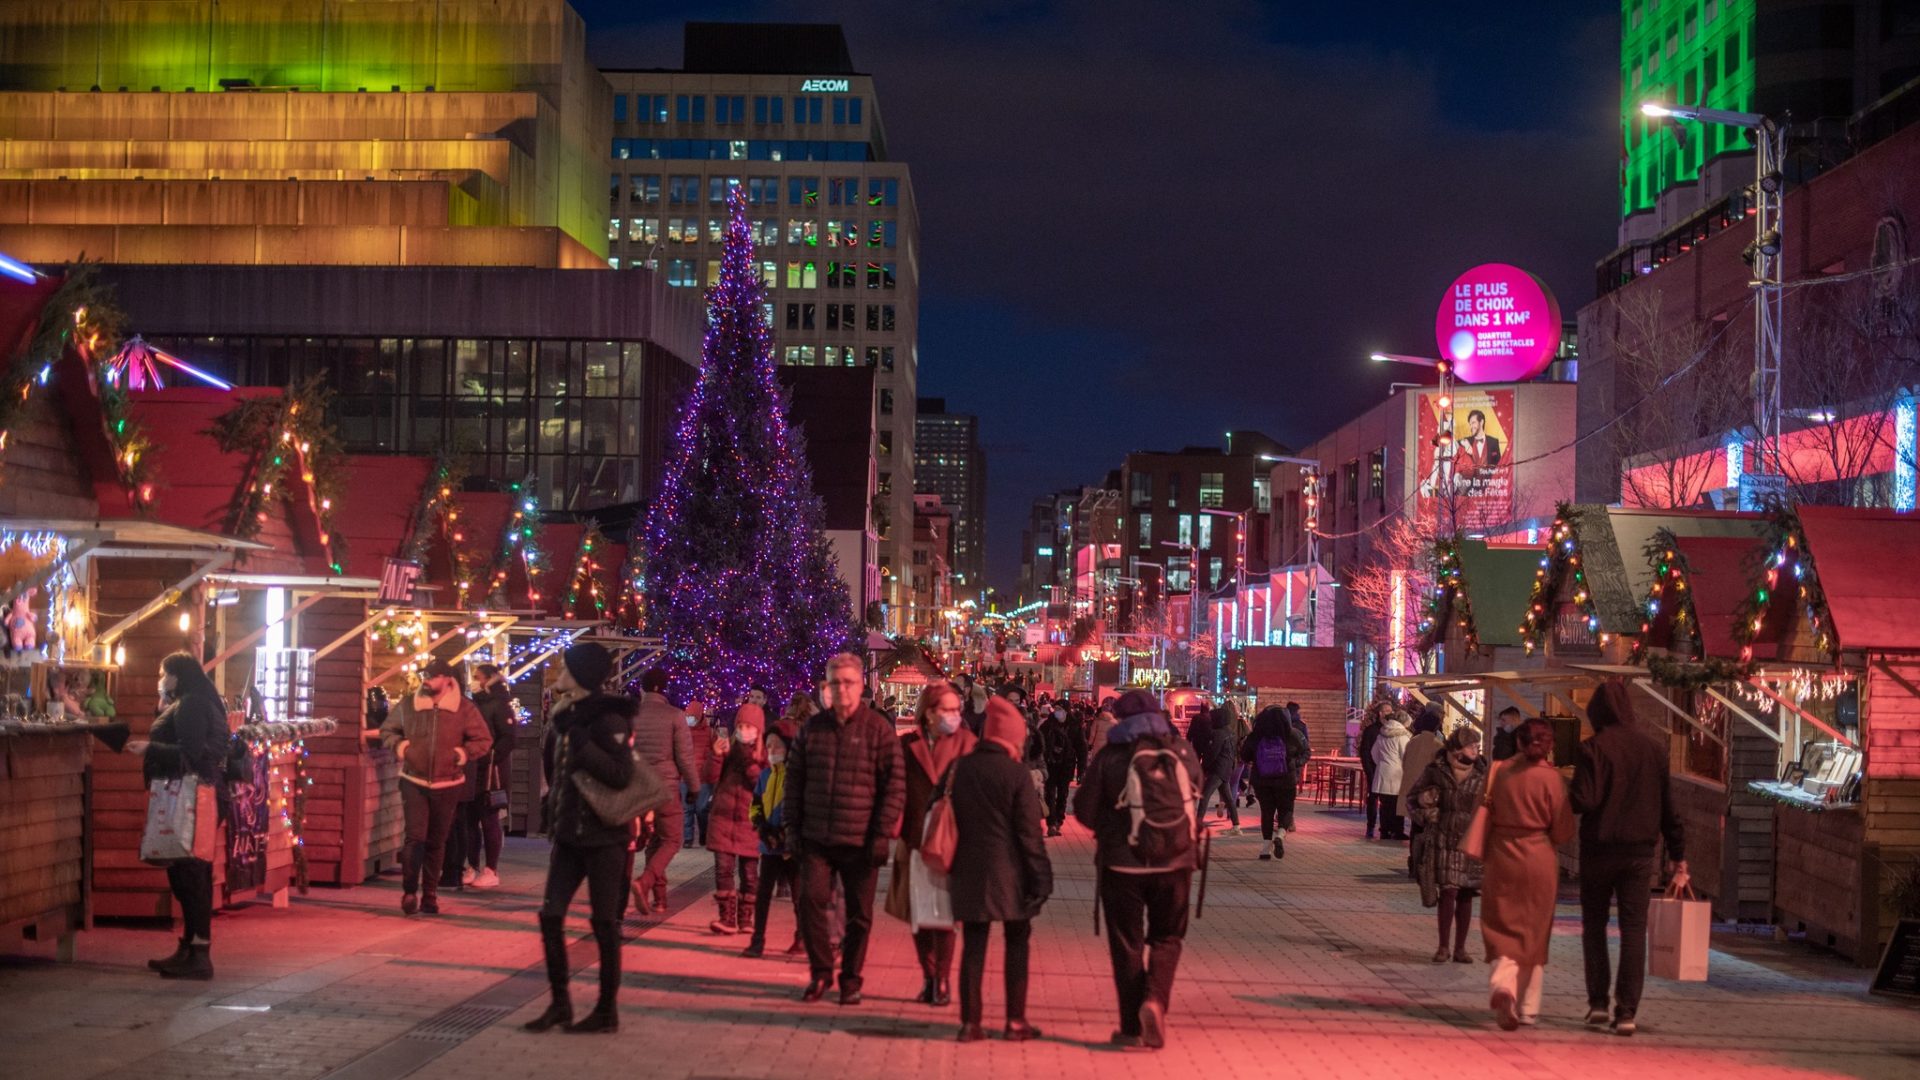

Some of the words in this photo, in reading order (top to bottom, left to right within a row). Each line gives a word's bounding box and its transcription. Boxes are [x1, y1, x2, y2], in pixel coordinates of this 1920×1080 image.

[801, 79, 849, 92] AECOM
[1455, 285, 1471, 297] LE
[1475, 283, 1508, 296] PLUS
[1455, 299, 1472, 312] DE
[1476, 297, 1514, 310] CHOIX
[1455, 313, 1489, 327] DANS
[1492, 312, 1501, 326] 1
[1477, 331, 1512, 340] QUARTIER
[1477, 340, 1491, 348] DES
[1492, 338, 1535, 347] SPECTACLES
[1472, 477, 1481, 487] la
[1467, 487, 1483, 497] des
